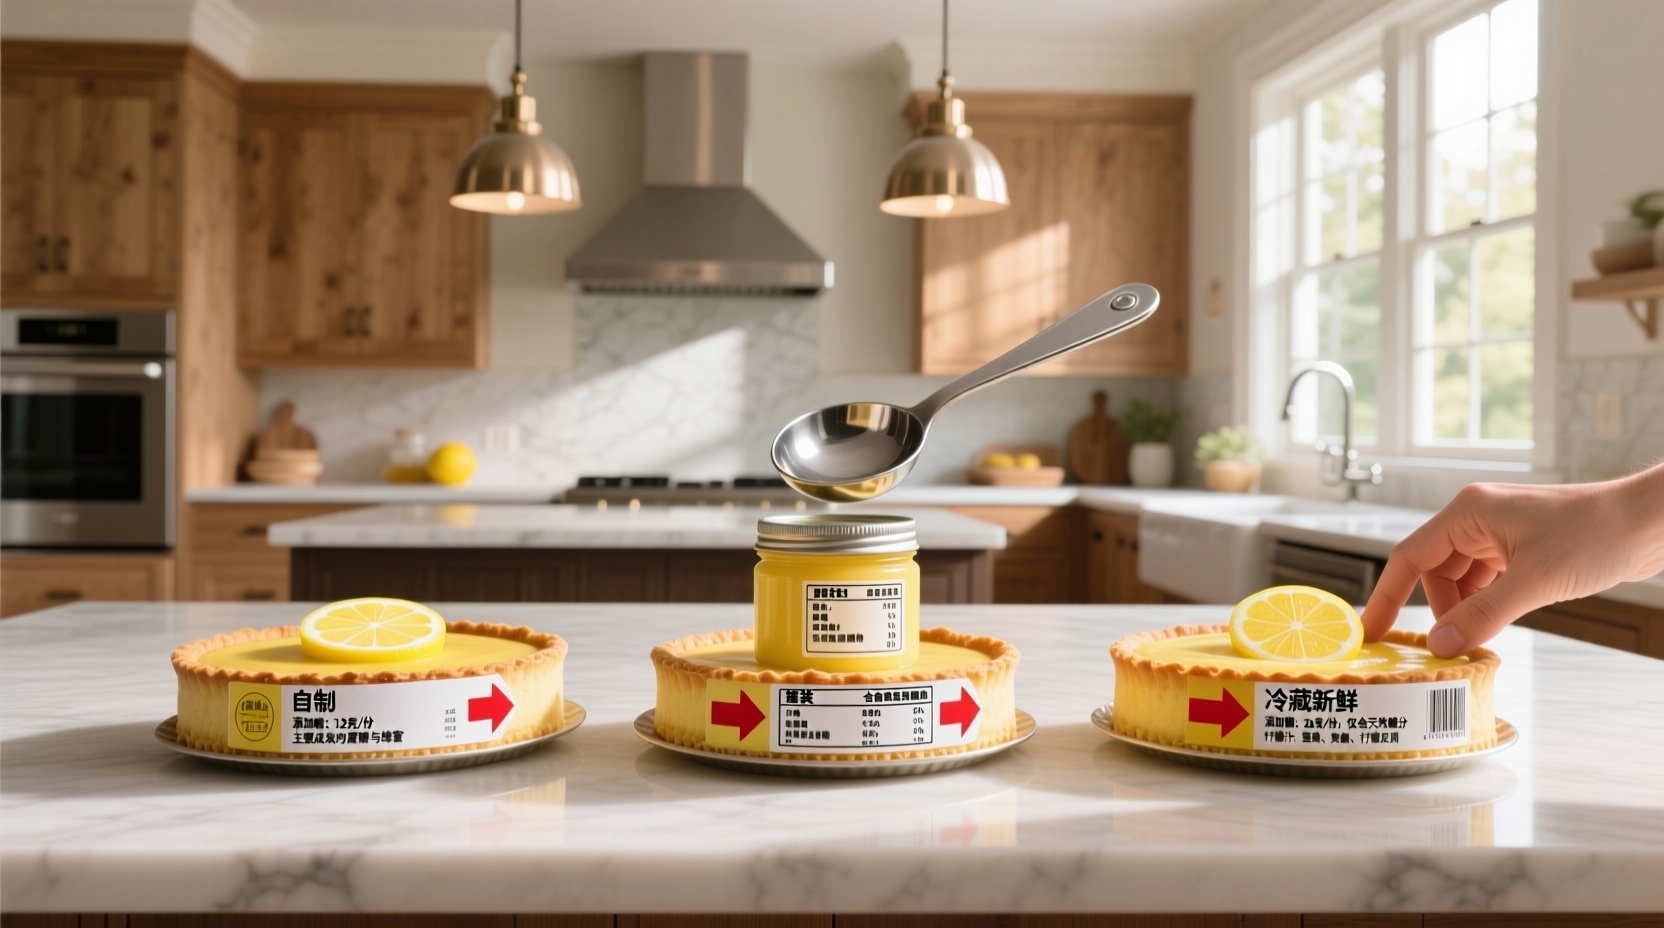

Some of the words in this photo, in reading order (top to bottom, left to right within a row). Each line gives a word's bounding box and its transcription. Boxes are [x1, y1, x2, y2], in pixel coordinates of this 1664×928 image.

[293, 688, 336, 713] 自制
[1265, 688, 1358, 713] 冷藏新鲜
